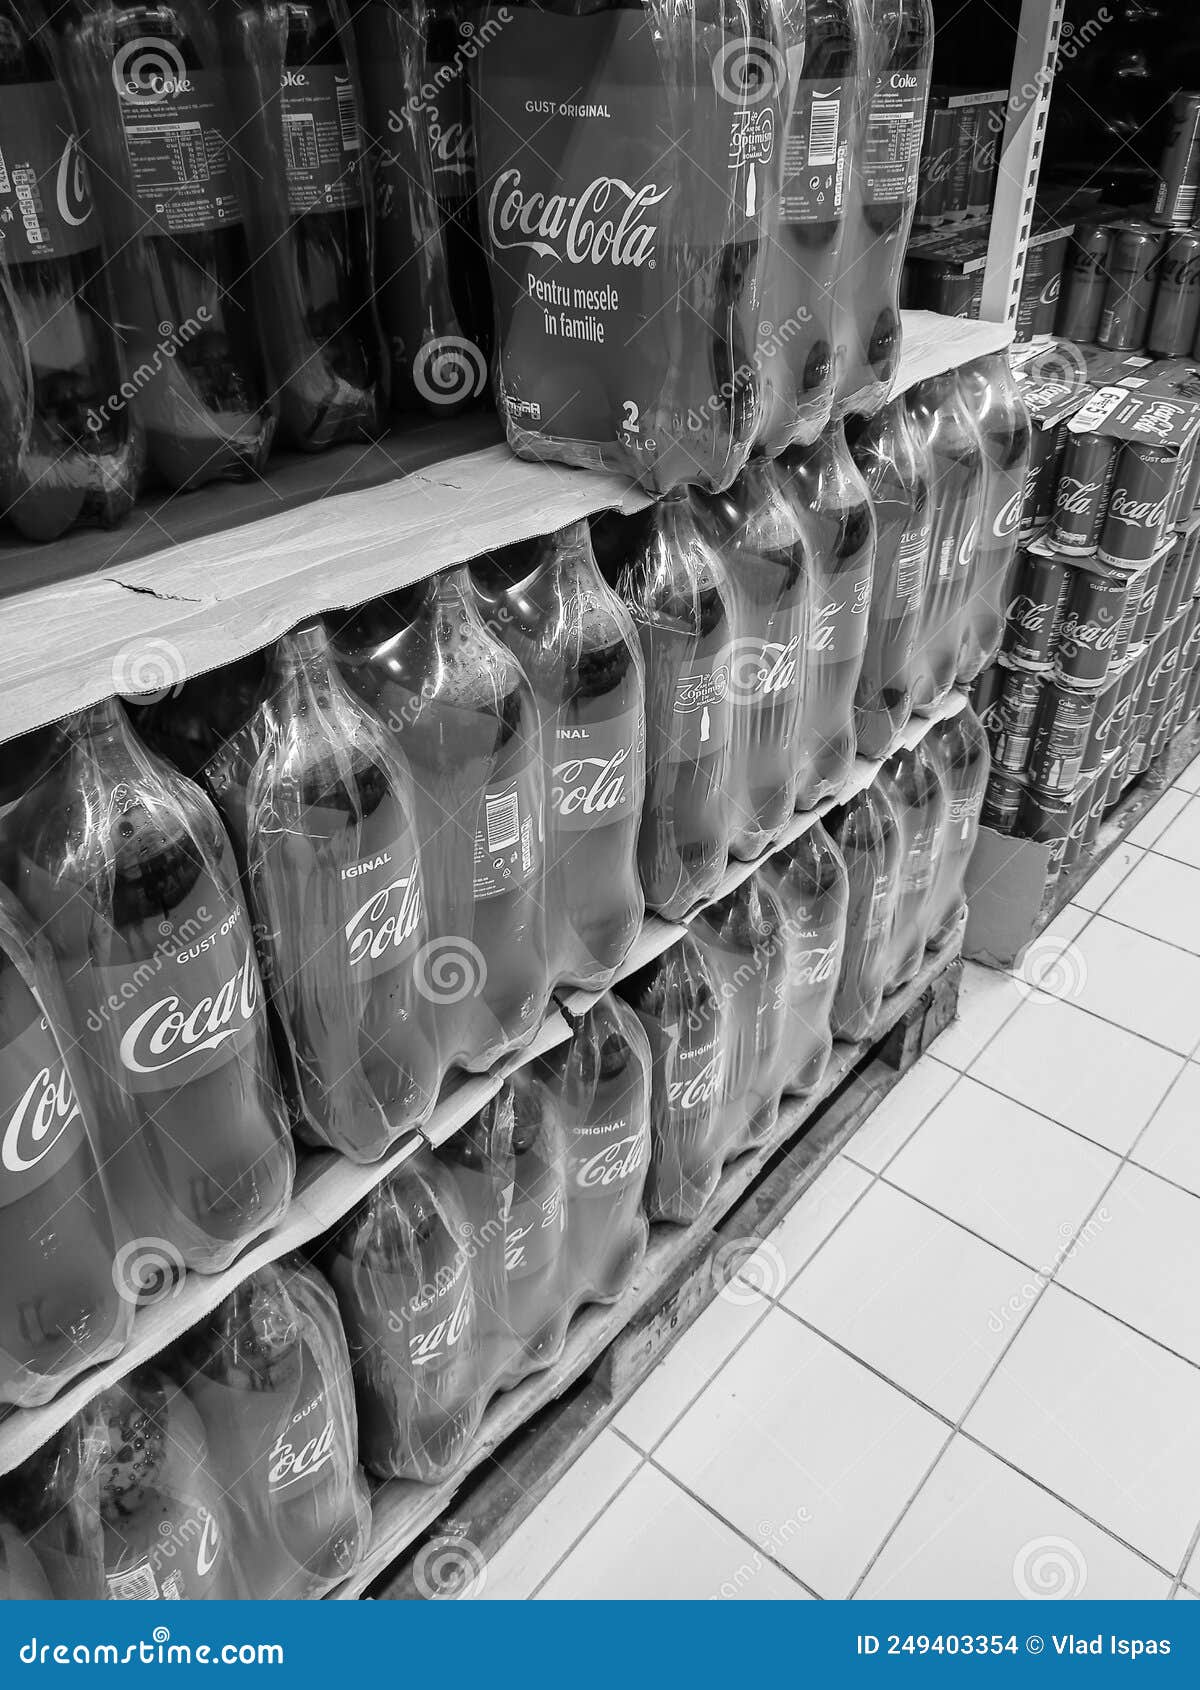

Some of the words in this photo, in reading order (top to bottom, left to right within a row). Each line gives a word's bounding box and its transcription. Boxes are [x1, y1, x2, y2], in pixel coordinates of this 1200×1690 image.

[525, 100, 556, 114] GUST
[559, 104, 611, 118] ORIGINAL
[488, 168, 673, 268] Coca-Cola
[526, 273, 571, 308] Pentru
[573, 284, 619, 311] mesele
[543, 308, 558, 335] în
[560, 312, 605, 344] familie
[622, 400, 640, 433] 2
[341, 853, 392, 881] IGINAL
[176, 932, 217, 965] GUST
